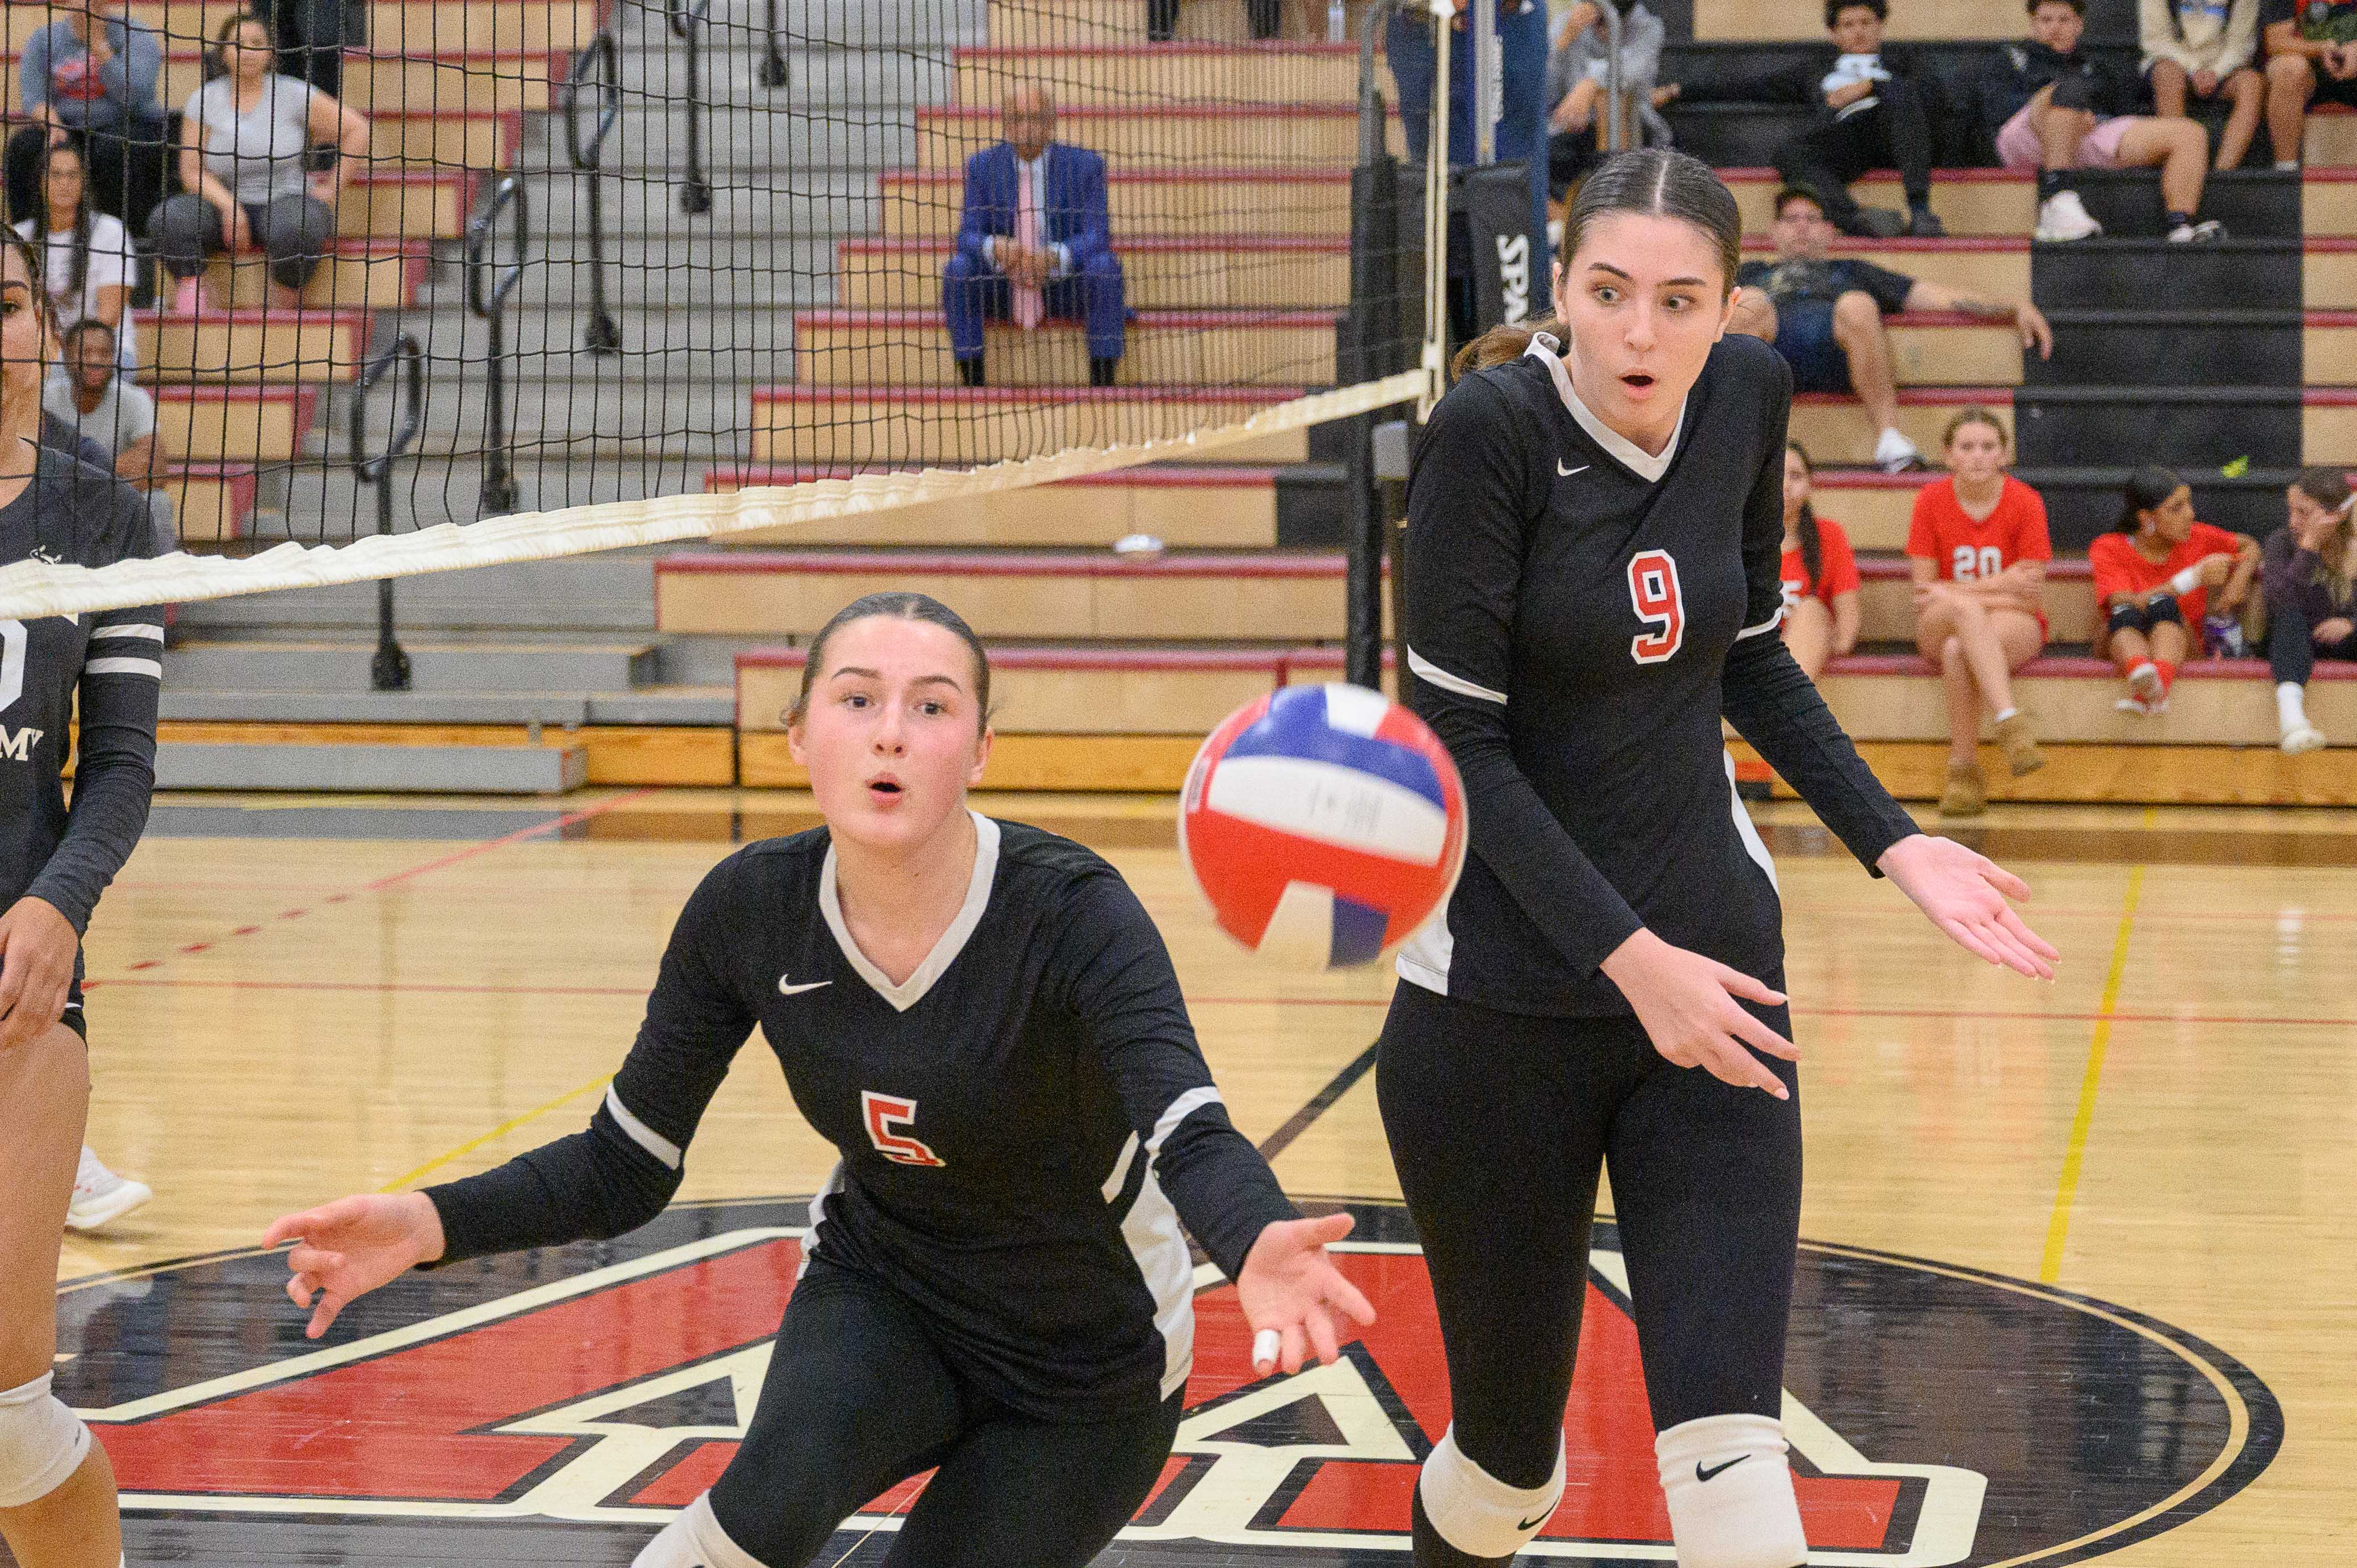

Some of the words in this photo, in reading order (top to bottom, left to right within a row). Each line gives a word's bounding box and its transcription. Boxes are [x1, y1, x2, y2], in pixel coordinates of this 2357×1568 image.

[1496, 234, 1530, 330] SPA
[1953, 545, 2002, 581] 20
[1627, 549, 1685, 665] 9
[861, 1090, 947, 1167] 5
